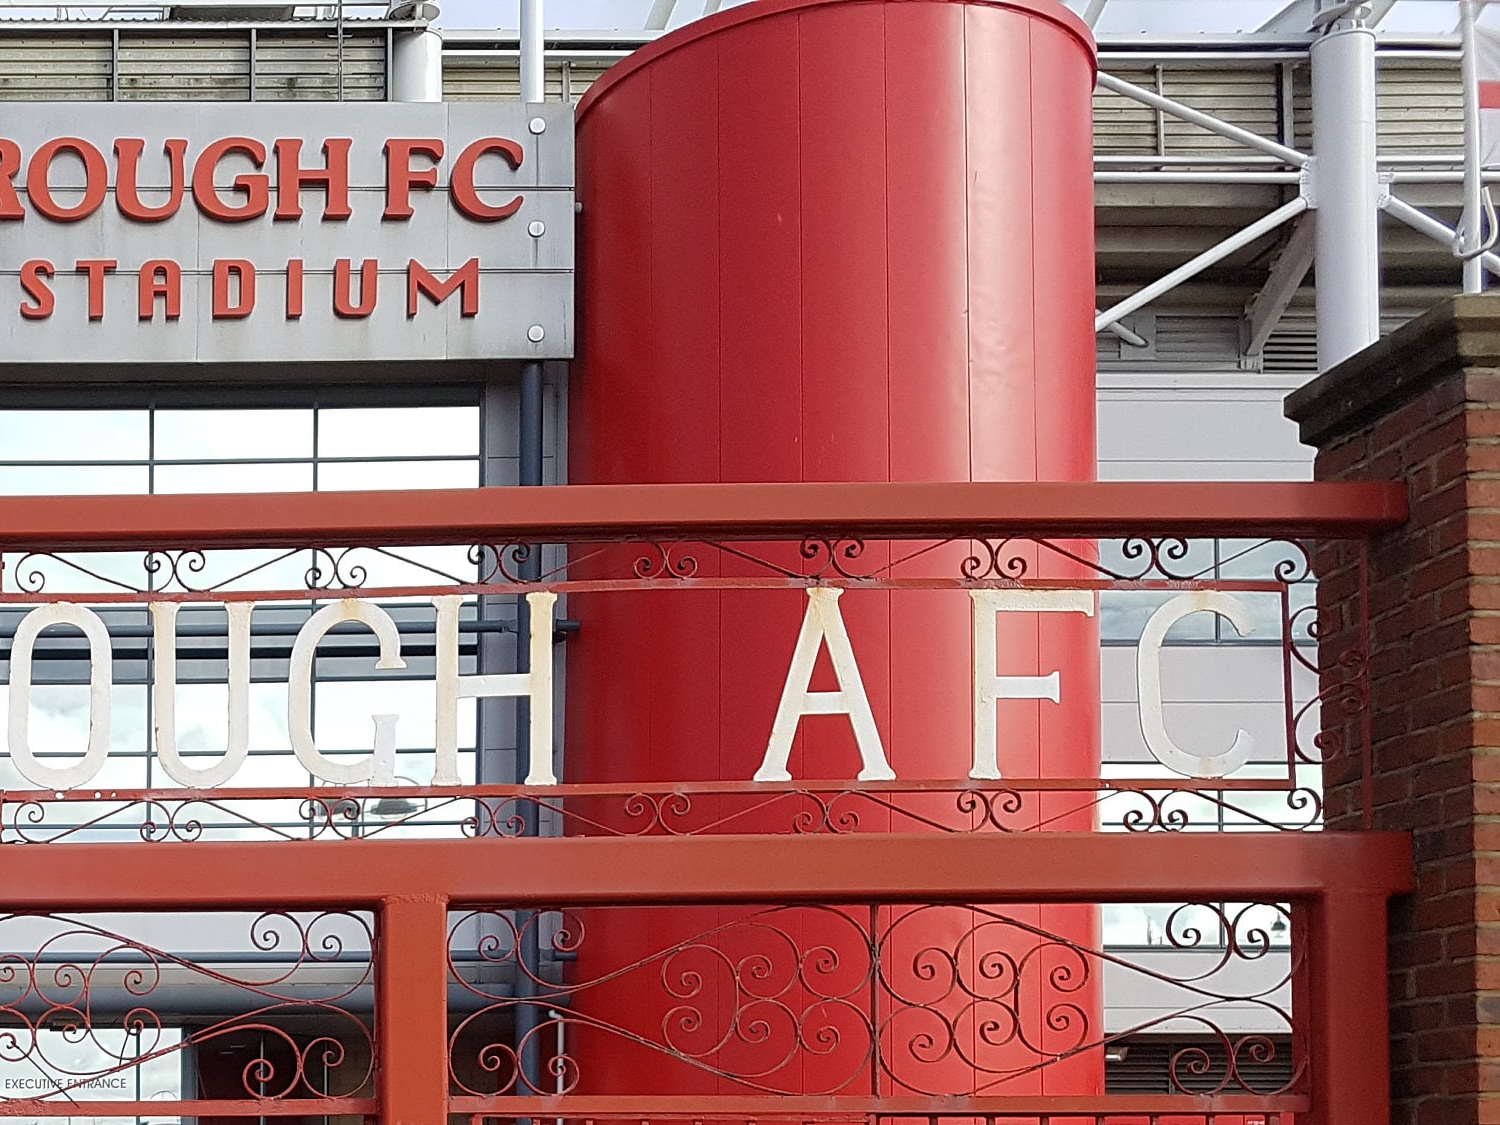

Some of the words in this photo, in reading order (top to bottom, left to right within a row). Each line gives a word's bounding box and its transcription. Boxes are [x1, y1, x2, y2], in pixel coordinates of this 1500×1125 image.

[384, 136, 524, 222] FC
[19, 256, 479, 320] STADIUM
[5, 1078, 64, 1089] EXECUTIVE
[67, 1078, 127, 1089] ENTRANCE
